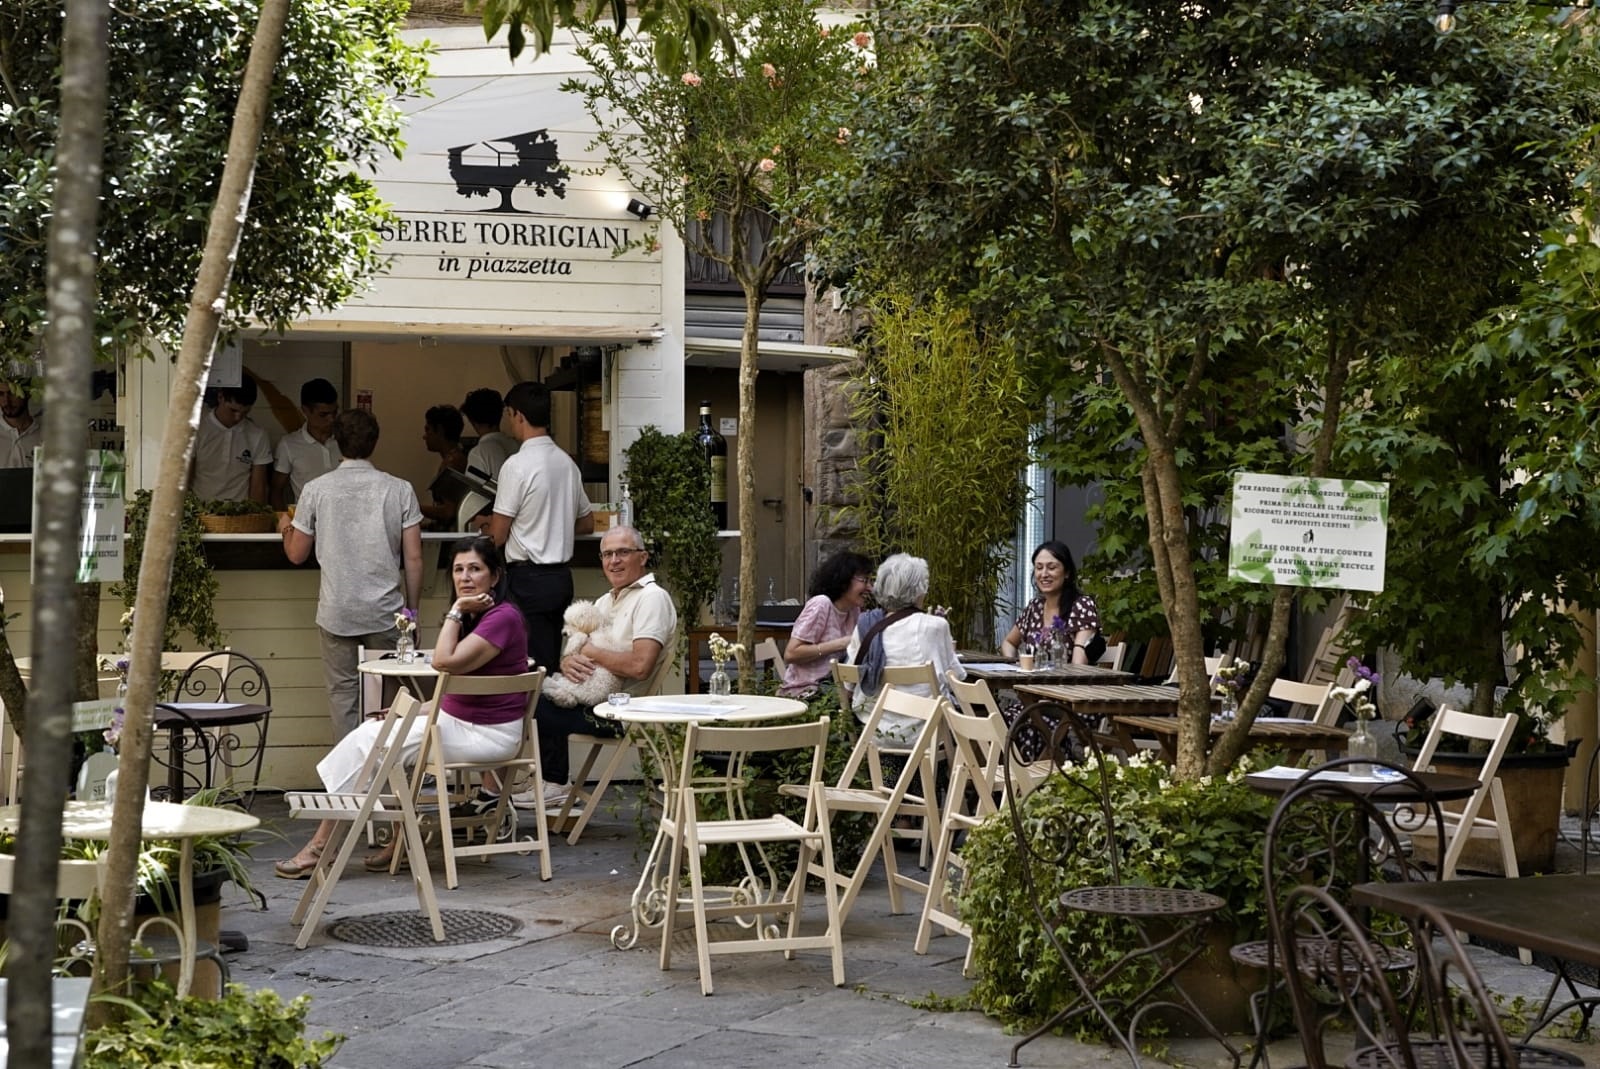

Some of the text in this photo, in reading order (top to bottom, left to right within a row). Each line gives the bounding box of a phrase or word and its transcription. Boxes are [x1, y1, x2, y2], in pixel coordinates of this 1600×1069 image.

[379, 220, 630, 249] SERRE TORRIGIANI
[438, 250, 573, 278] in piazzetta
[1331, 512, 1378, 522] UTILIZZANDO
[1249, 543, 1278, 551] PLEASE
[1336, 548, 1373, 557] COUNTER
[1274, 558, 1308, 566] LEAVING
[1310, 560, 1338, 568] KINDLY
[1340, 562, 1375, 570] RECYCLE
